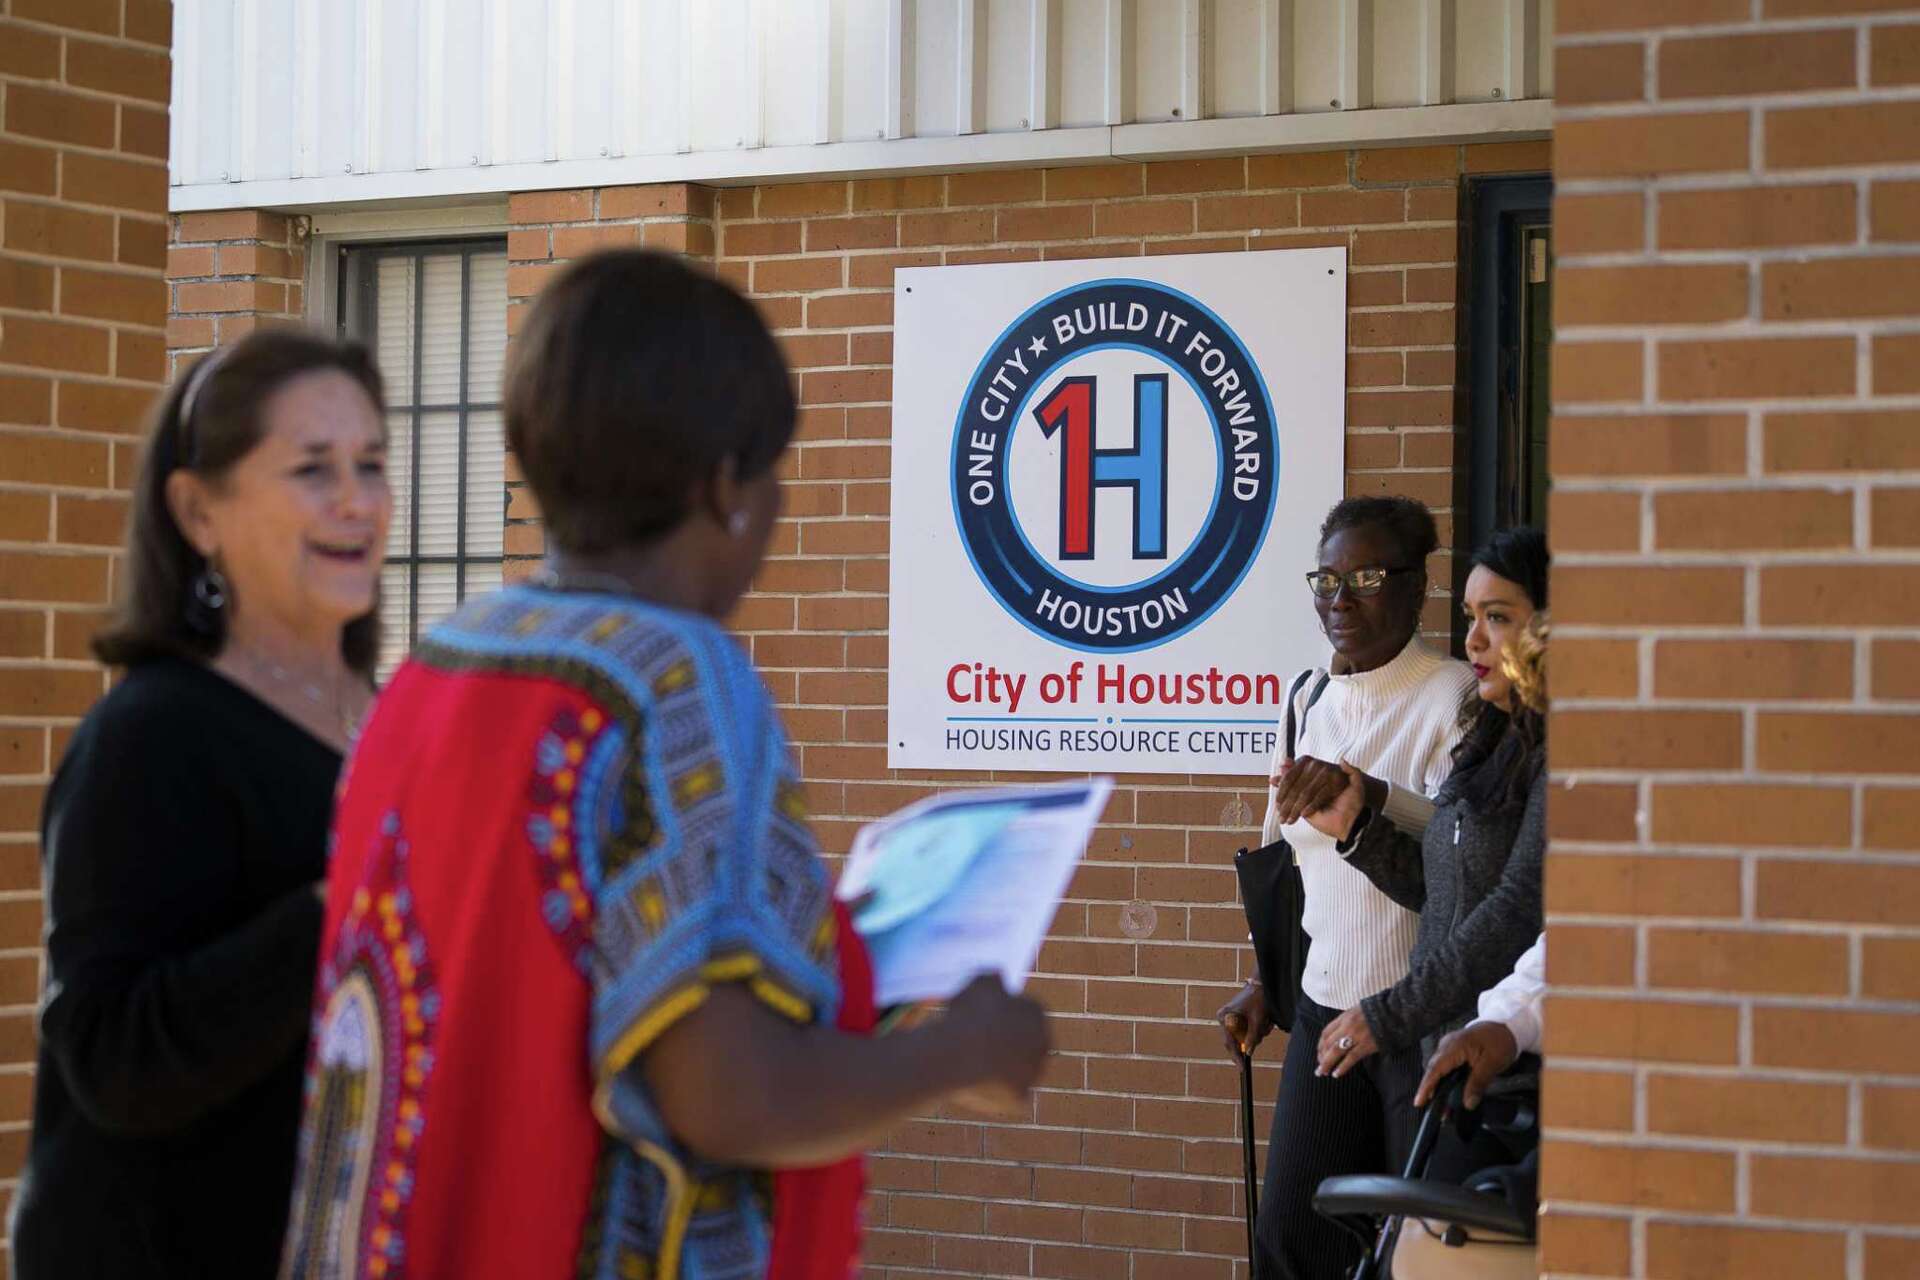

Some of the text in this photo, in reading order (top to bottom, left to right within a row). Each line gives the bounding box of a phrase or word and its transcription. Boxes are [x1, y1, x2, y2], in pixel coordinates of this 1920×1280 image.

[968, 302, 1261, 506] ONE CITY BUILD IT FORWARD
[1033, 373, 1168, 560] 1H
[1036, 587, 1189, 637] HOUSTON
[947, 662, 1280, 713] City of Houston
[946, 728, 1277, 754] HOUSING RESOURCE CENTER
